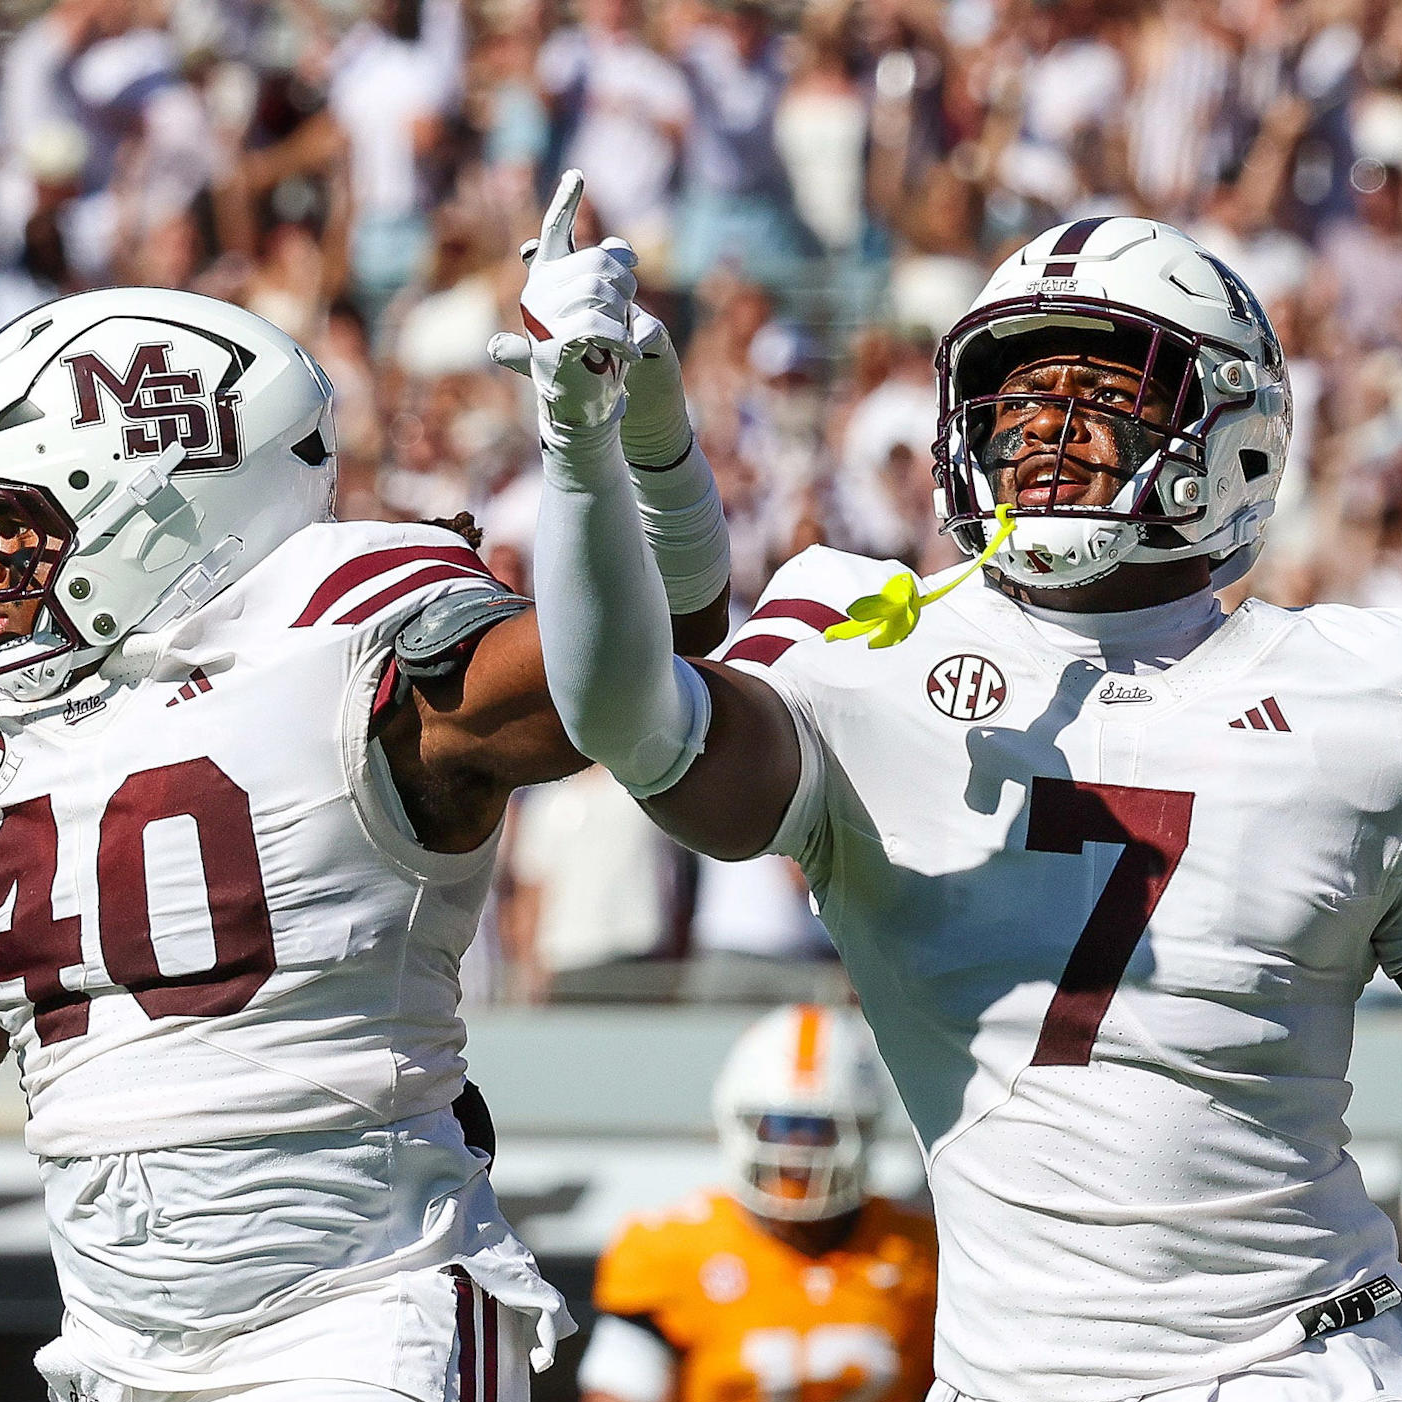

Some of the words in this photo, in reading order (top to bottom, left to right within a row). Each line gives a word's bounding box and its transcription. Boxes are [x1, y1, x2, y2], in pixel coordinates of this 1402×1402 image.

[1025, 279, 1079, 294] STATE
[60, 341, 248, 478] MSU
[62, 695, 107, 725] State
[927, 654, 1007, 720] SEC
[1098, 681, 1153, 704] State
[1025, 776, 1196, 1067] 7
